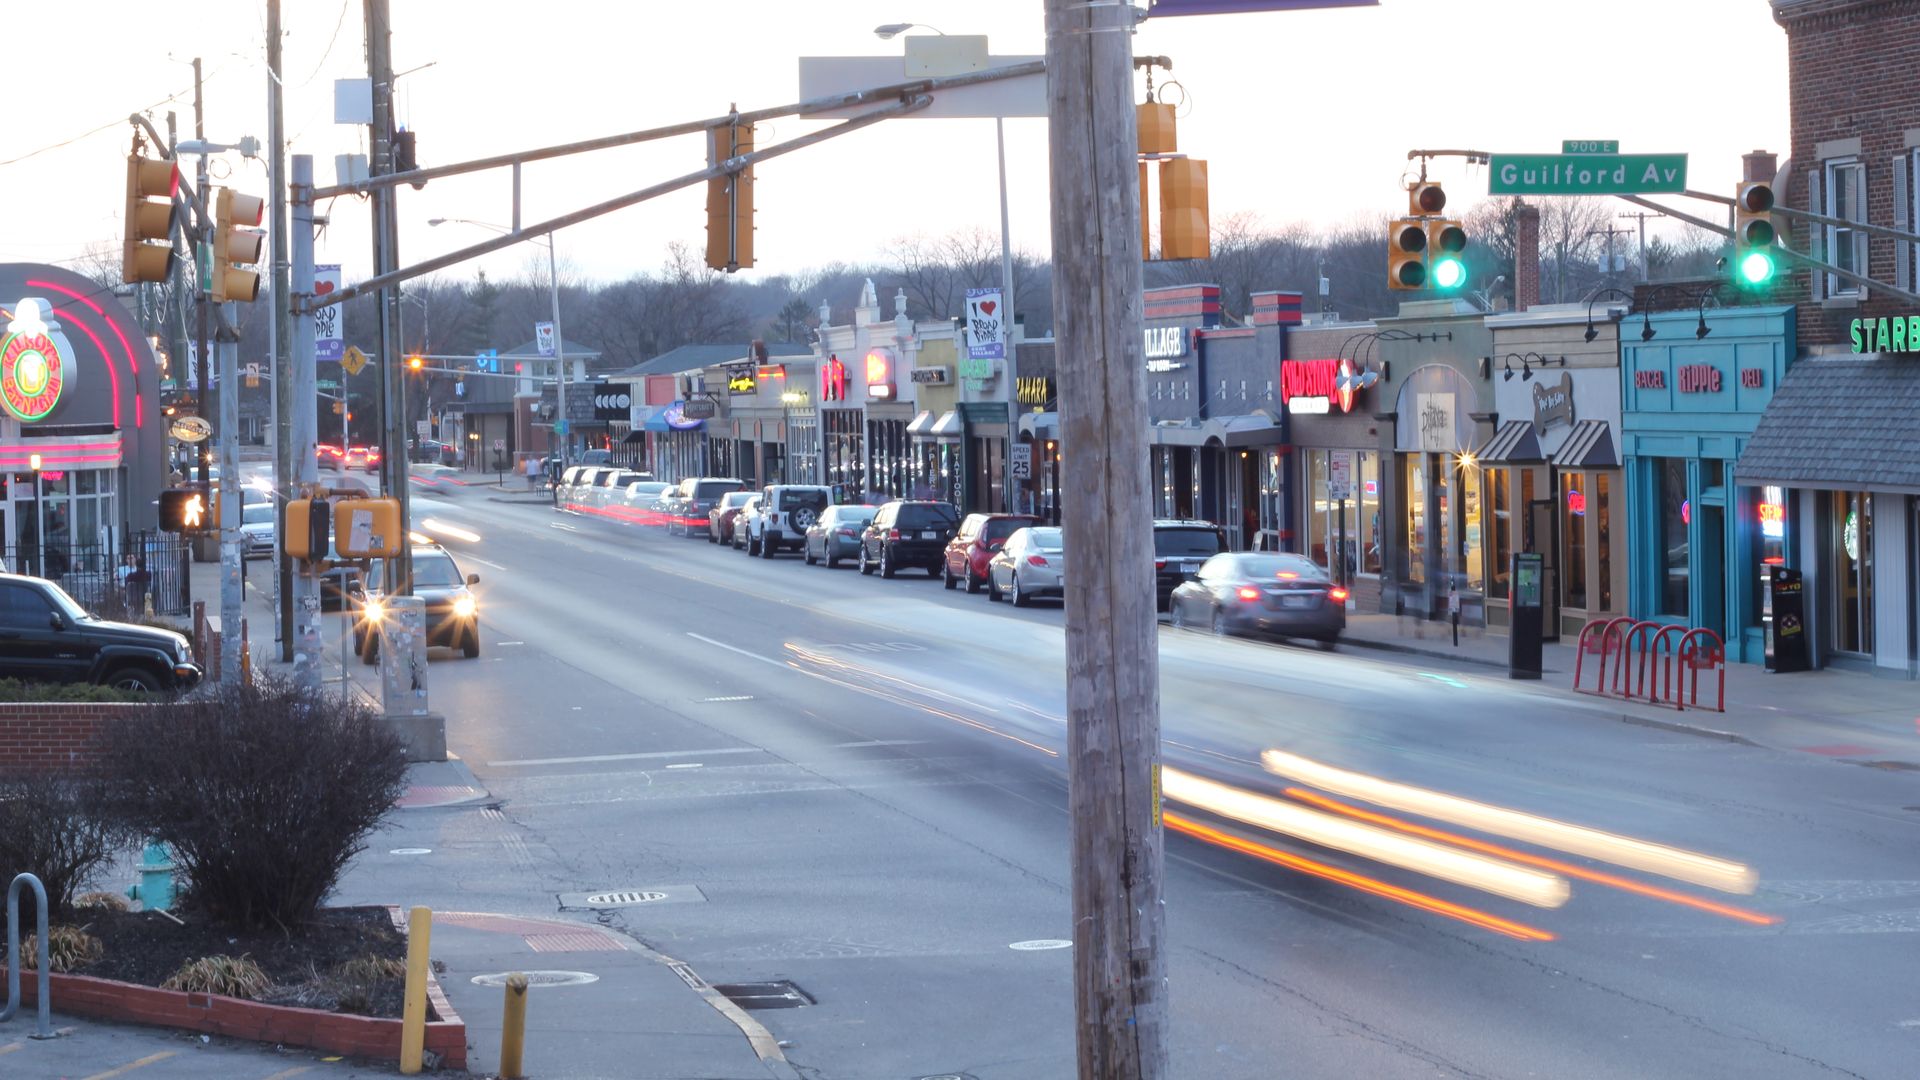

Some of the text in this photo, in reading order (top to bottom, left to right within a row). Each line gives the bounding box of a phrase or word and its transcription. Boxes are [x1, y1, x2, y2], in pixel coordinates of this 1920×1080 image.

[1570, 141, 1611, 152] 900 E
[1500, 161, 1678, 185] Guilford Av
[315, 306, 336, 322] OAD
[971, 319, 998, 331] BROAD
[1850, 315, 1920, 354] STARB
[1144, 327, 1181, 357] ILLAGE
[1281, 359, 1338, 405] COLD STONE
[1635, 369, 1664, 389] BAGEL
[1741, 368, 1763, 388] DELI
[1013, 461, 1029, 474] 25
